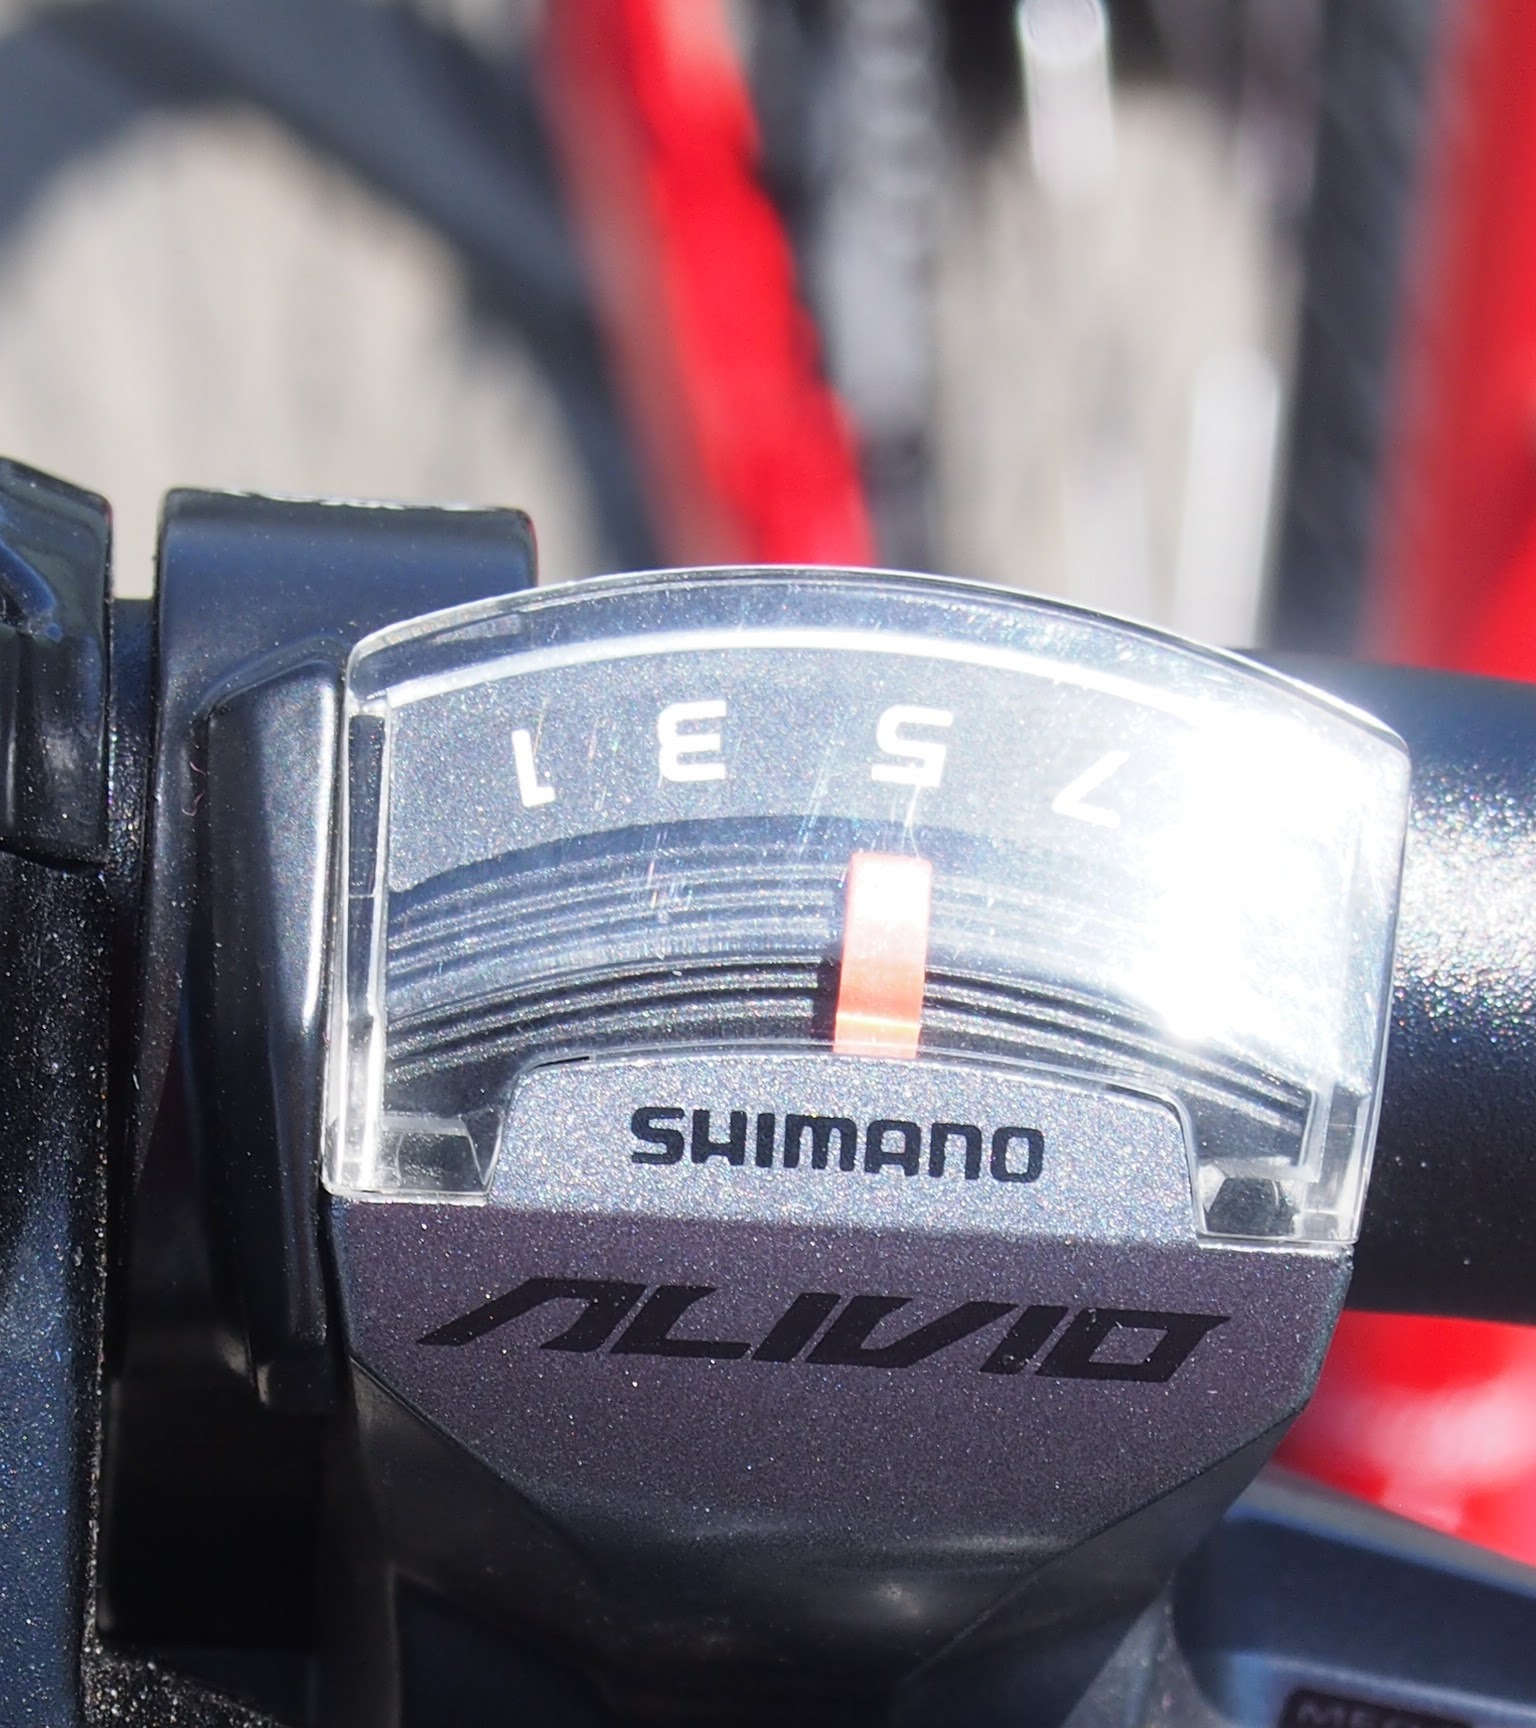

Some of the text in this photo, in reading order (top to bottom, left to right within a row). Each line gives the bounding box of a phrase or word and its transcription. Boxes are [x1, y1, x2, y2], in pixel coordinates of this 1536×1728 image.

[510, 727, 556, 808] 1
[657, 698, 729, 784] 3
[870, 703, 954, 788] 5
[628, 1106, 1046, 1184] SHIMANO
[416, 1277, 1232, 1383] ALIVIO
